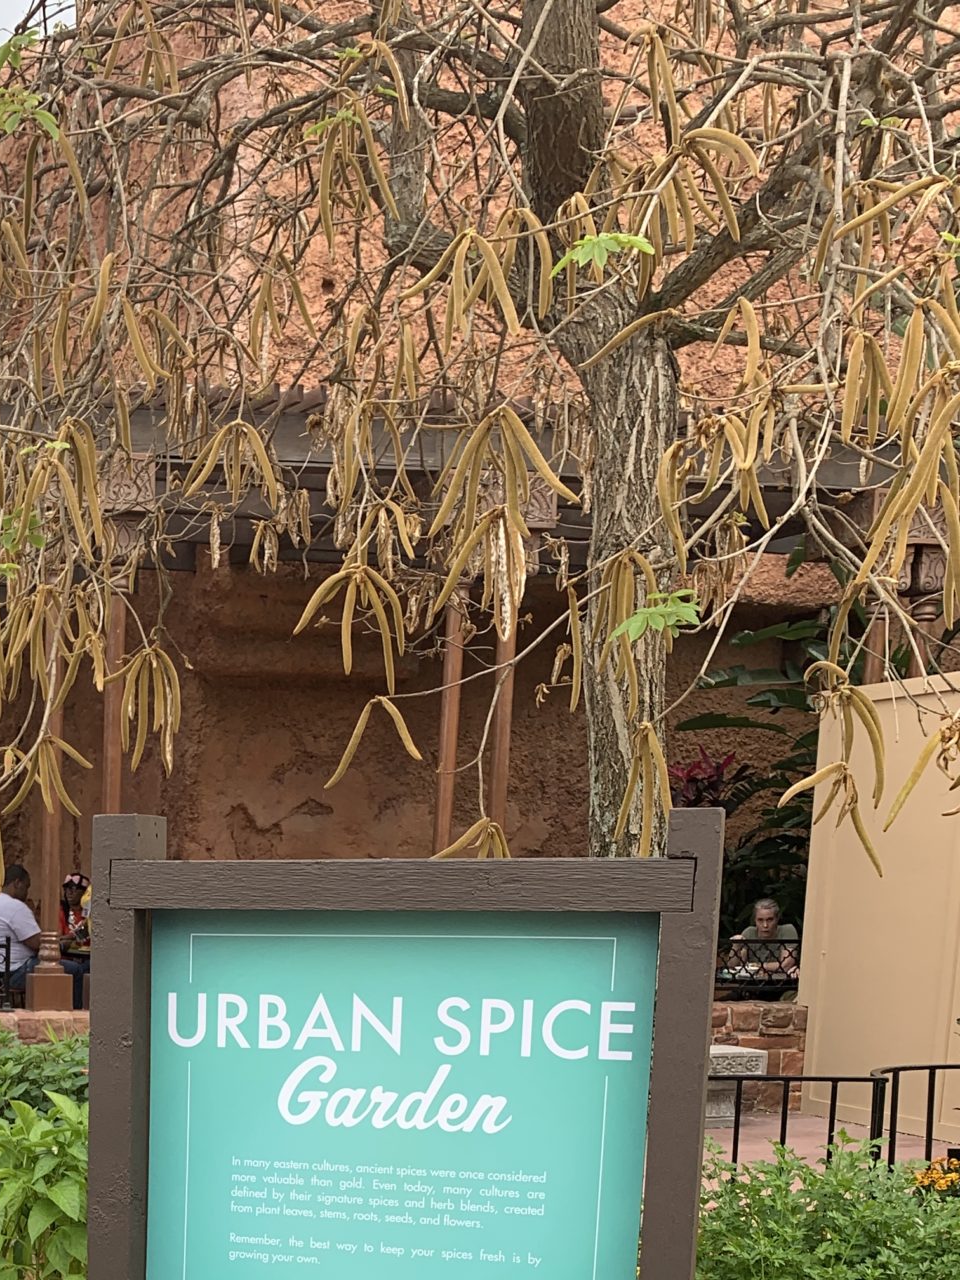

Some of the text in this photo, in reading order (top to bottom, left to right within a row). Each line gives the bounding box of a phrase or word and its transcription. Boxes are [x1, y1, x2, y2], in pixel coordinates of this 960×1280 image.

[167, 992, 636, 1061] URBAN SPICE
[276, 1056, 513, 1134] Garden
[231, 1155, 547, 1184] In many eastern cultures, ancient spices were once considered
[230, 1186, 545, 1217] defined by their signature spices and herb blends, created
[231, 1173, 546, 1200] more valuable than gold. Even today, many cultures are
[230, 1201, 484, 1229] from plant leaves, stems, roots, seeds, and flowers.
[228, 1250, 321, 1265] growing your own.
[229, 1232, 542, 1268] Remember, the best way to keep your spices fresh is by
